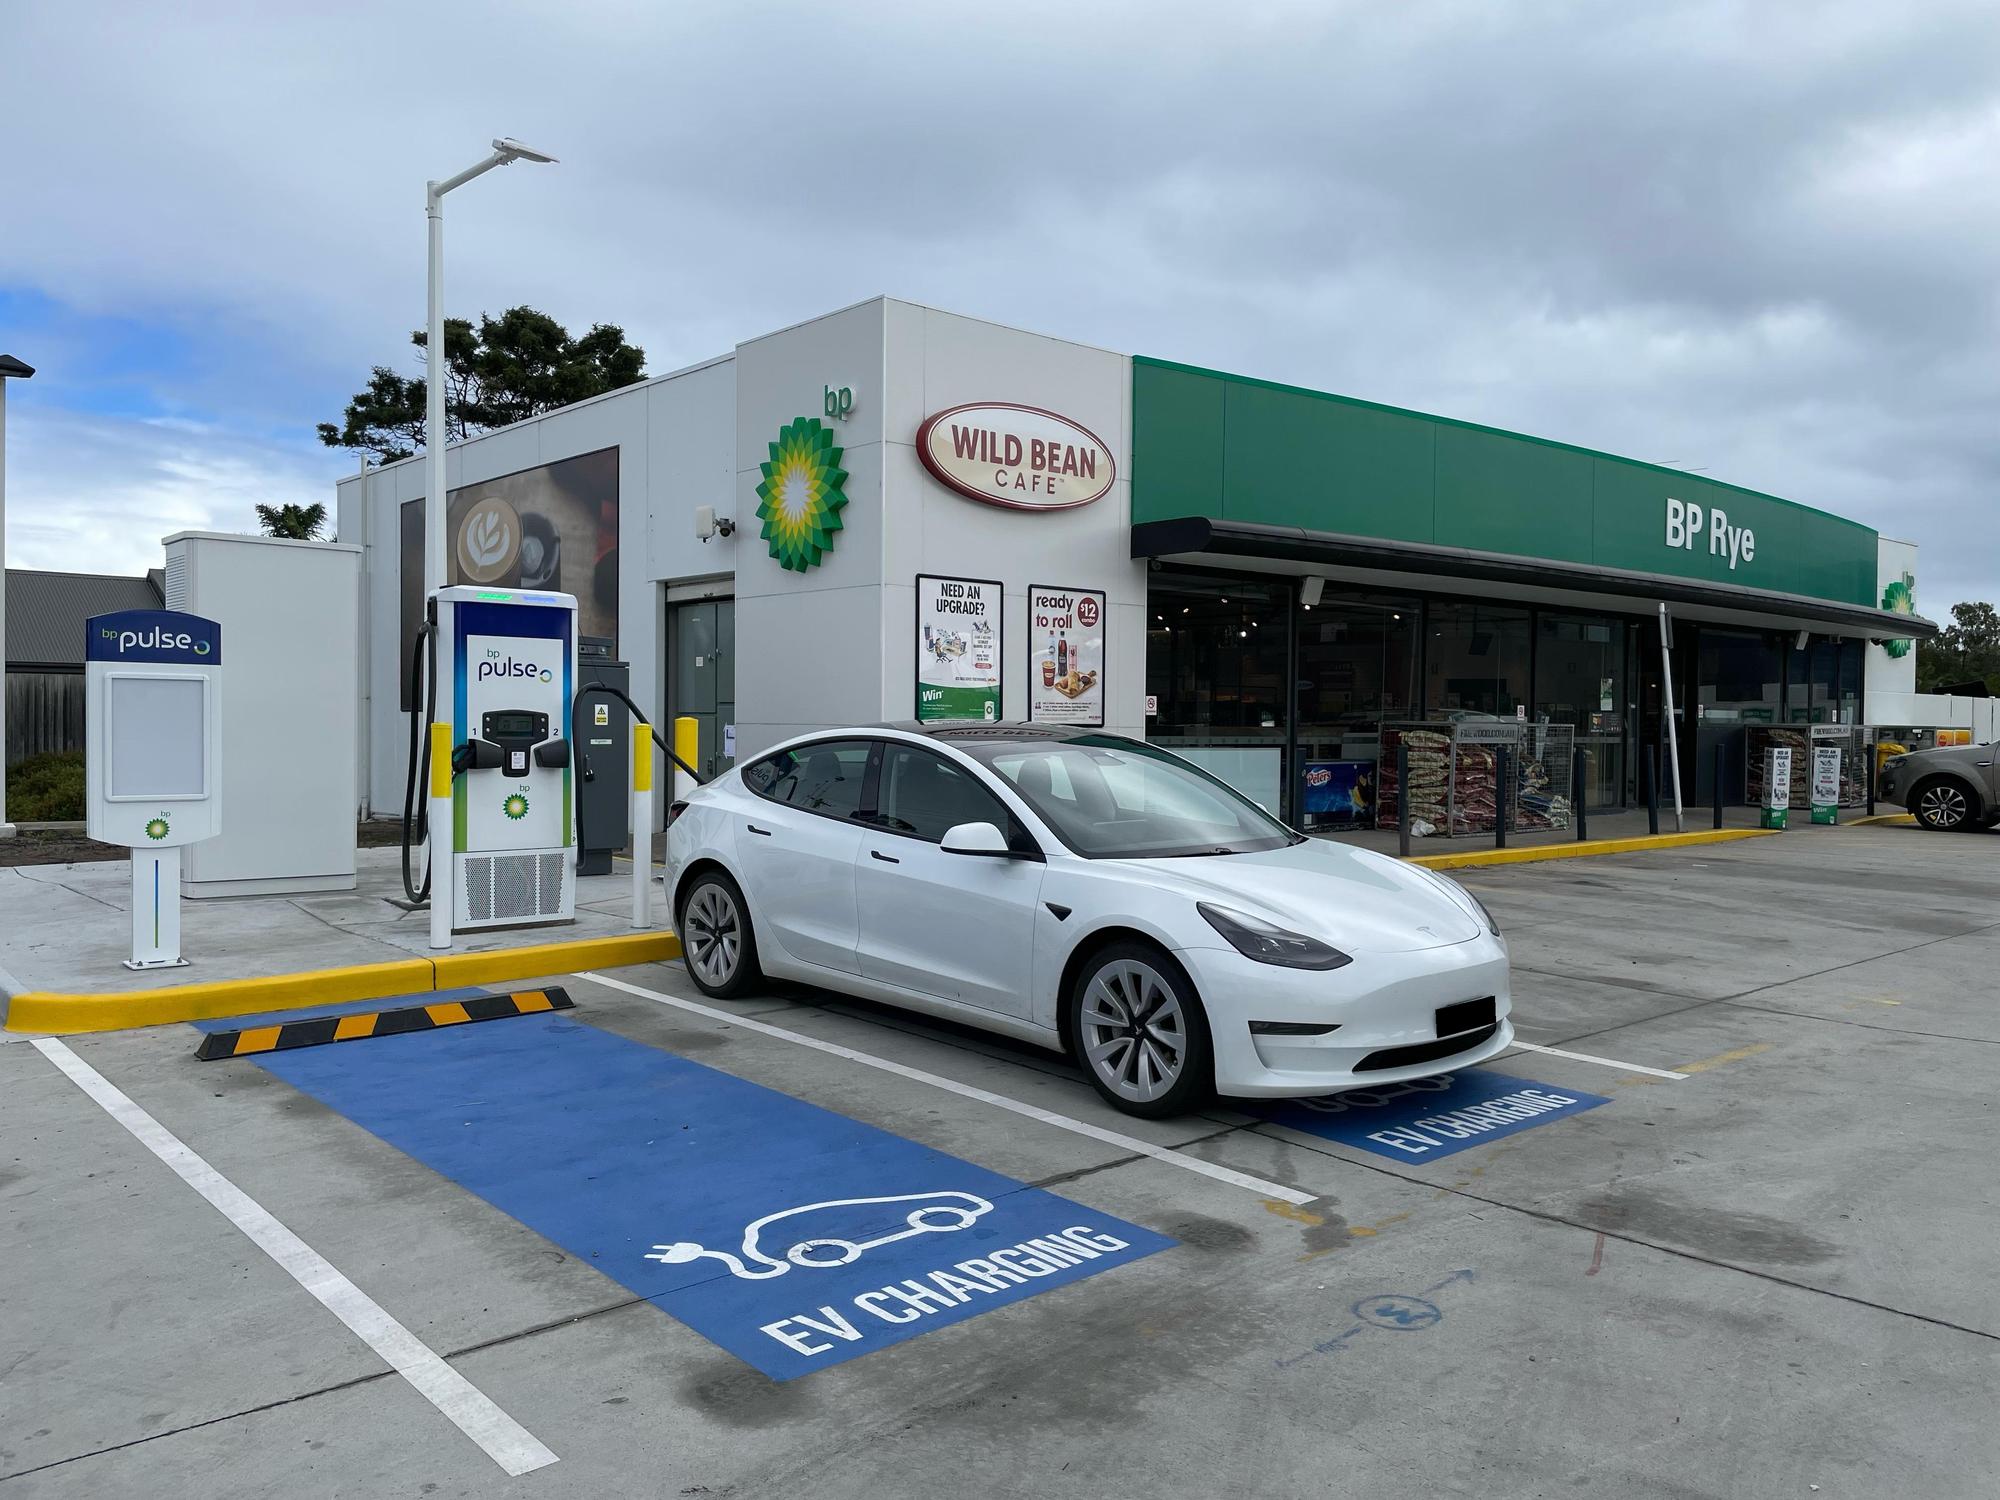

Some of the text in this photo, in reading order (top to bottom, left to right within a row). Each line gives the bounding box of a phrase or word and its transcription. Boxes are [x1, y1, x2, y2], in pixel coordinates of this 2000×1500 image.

[824, 384, 852, 421] bp
[951, 424, 1096, 480] WILD BEAN
[995, 469, 1056, 495] CAFE
[1665, 498, 1755, 570] BP Rye
[941, 583, 980, 600] NEED AN
[936, 598, 985, 616] UPGRADE?
[1036, 593, 1074, 613] ready
[1080, 603, 1096, 617] $12
[1036, 613, 1073, 629] to roll
[102, 625, 192, 653] bp pulse
[487, 648, 500, 660] bp
[478, 656, 538, 681] pulse
[472, 728, 477, 736] 1
[553, 728, 559, 736] 2
[1306, 771, 1332, 787] Peters
[520, 784, 531, 793] bp
[160, 810, 171, 818] bp
[1365, 1089, 1579, 1154] EV CHARGING
[759, 1225, 1131, 1357] EV CHARGING
